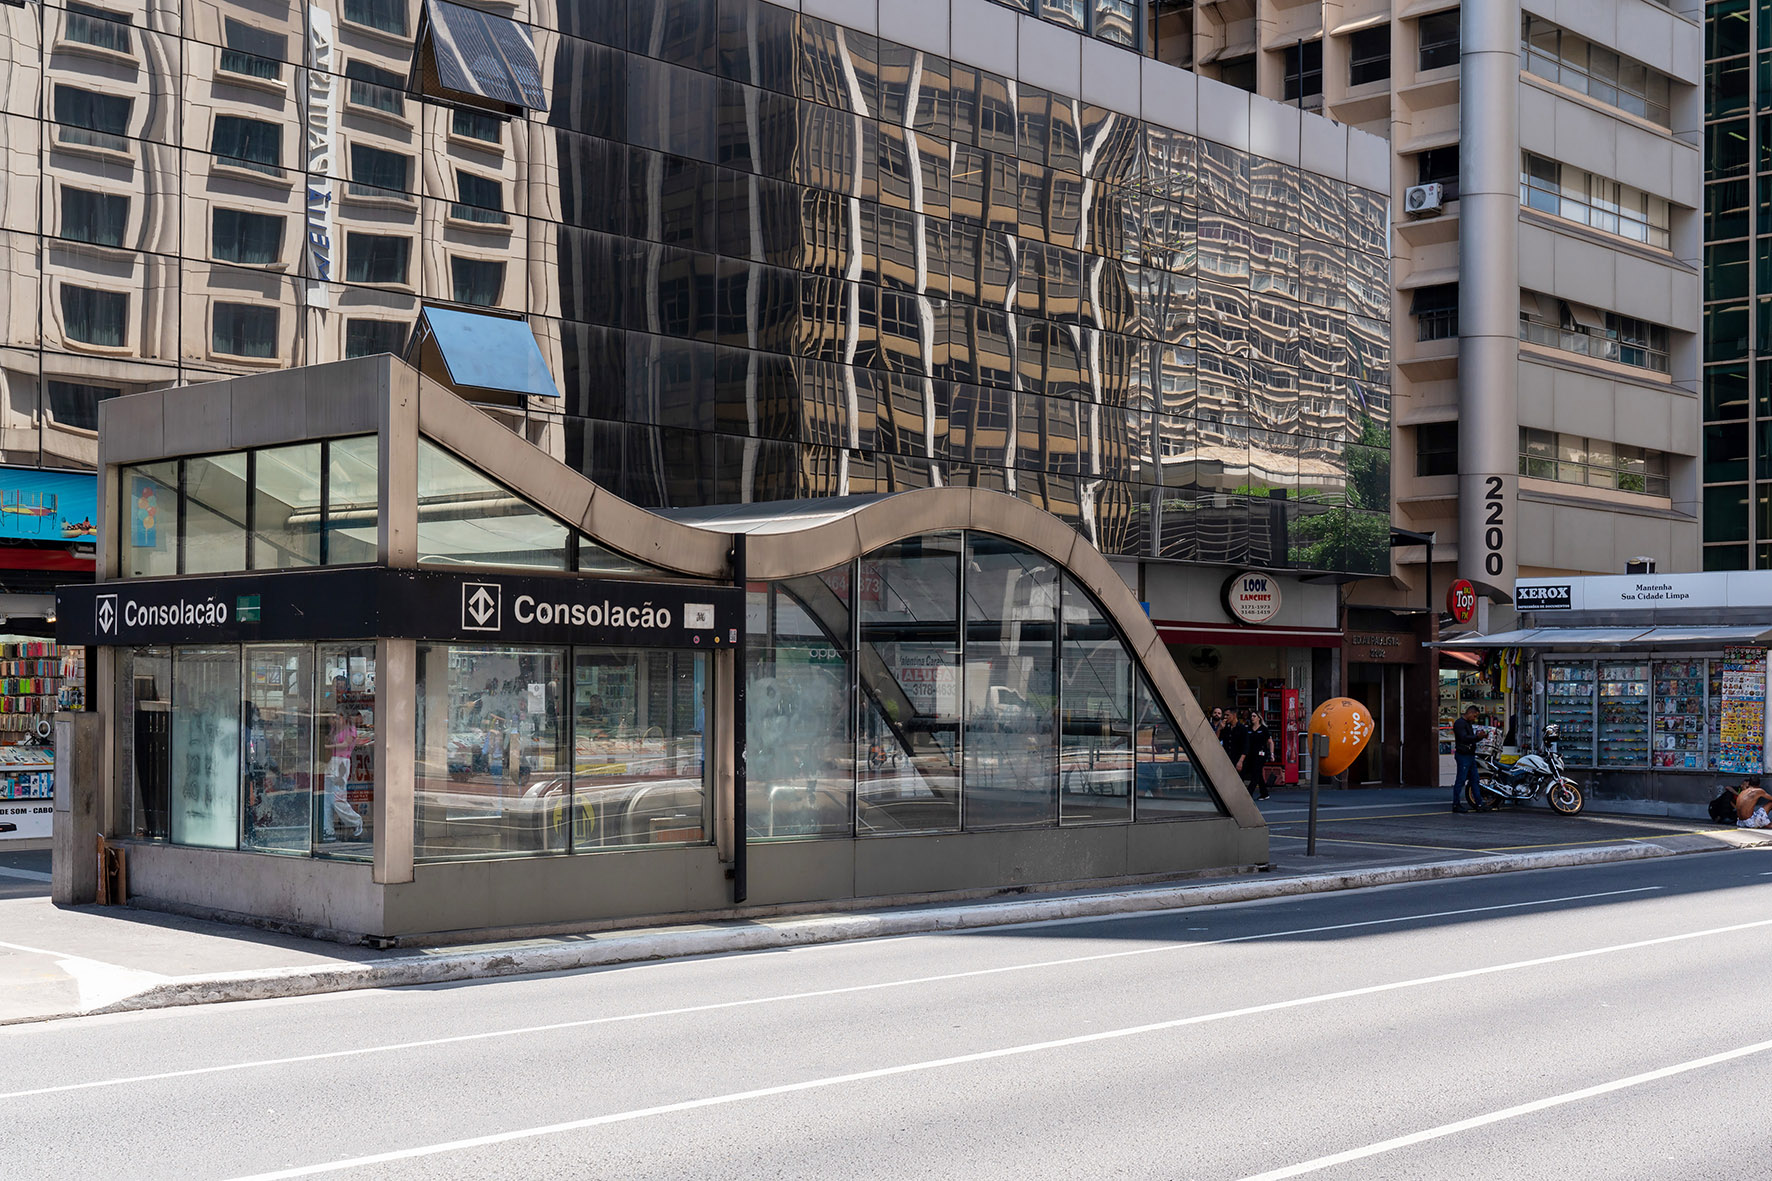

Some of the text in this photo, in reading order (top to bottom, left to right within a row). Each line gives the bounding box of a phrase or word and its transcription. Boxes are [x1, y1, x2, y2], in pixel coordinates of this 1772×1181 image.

[1485, 476, 1503, 576] 2200
[1243, 579, 1267, 592] LOOK
[1635, 584, 1672, 592] Mantenha
[1240, 594, 1271, 602] LANCHES
[1518, 587, 1568, 599] XEROX
[1637, 592, 1664, 600] Cidade
[1665, 592, 1689, 600] Limpa
[1456, 591, 1473, 610] Top
[1350, 712, 1361, 746] vivo
